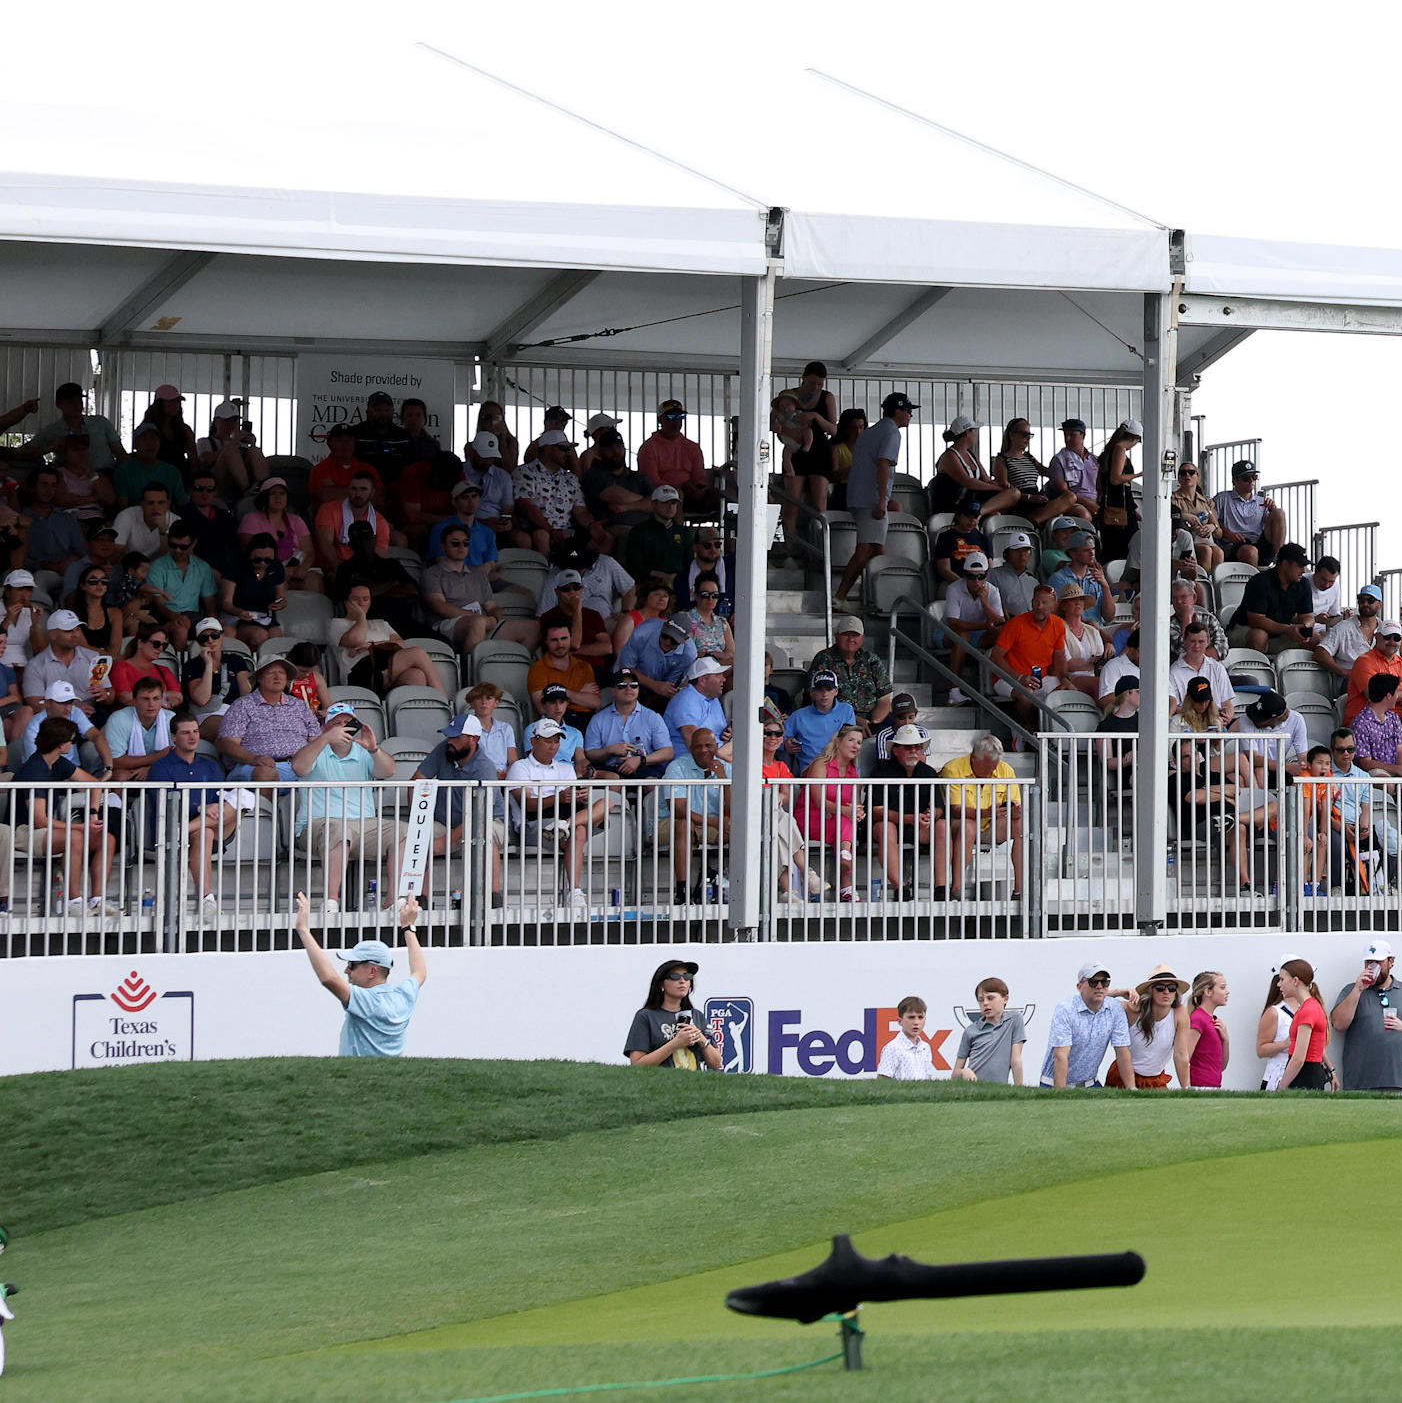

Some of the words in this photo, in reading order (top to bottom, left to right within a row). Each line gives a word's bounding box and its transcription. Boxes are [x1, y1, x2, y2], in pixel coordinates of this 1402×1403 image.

[330, 371, 362, 384] Shade
[366, 374, 408, 386] provided
[411, 375, 422, 388] by
[331, 395, 369, 403] UNIVERS
[411, 800, 429, 869] QUIET
[710, 1009, 732, 1018] PGA
[109, 1018, 158, 1035] Texas
[90, 1039, 176, 1059] Children's
[711, 1018, 724, 1070] TO
